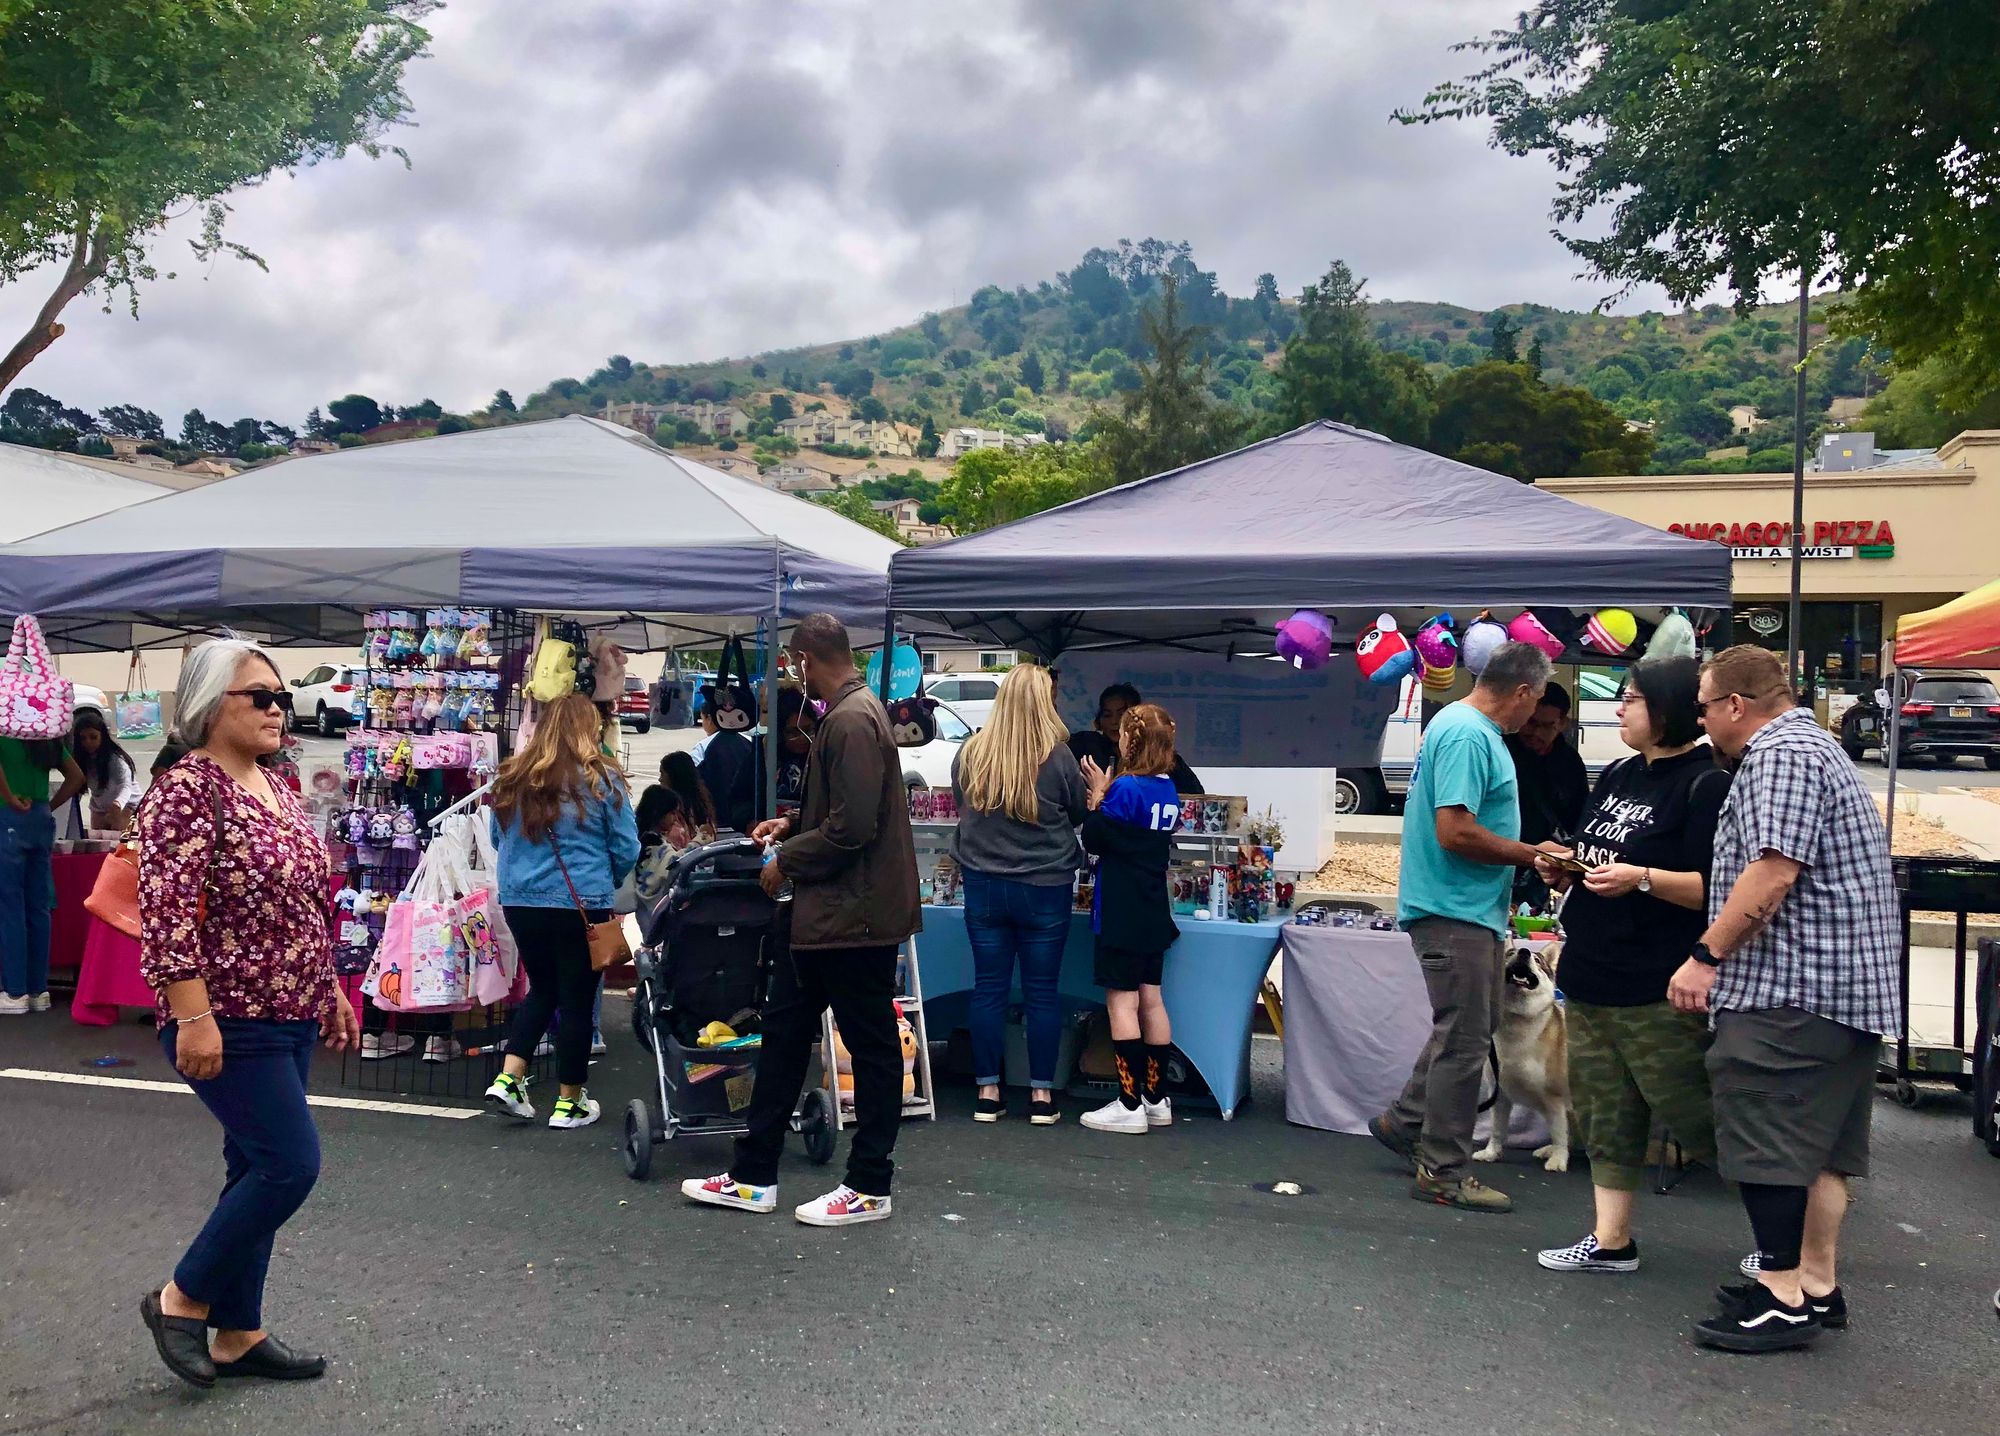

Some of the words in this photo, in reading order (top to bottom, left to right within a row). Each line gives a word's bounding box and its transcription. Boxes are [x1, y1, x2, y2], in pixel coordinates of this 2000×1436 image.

[1814, 521, 1894, 546] PIZZA
[1733, 548, 1763, 557] ITH
[1769, 548, 1782, 557] A
[1754, 615, 1778, 626] 805
[870, 663, 916, 687] Wlcome
[1600, 794, 1652, 821] NEVER
[1584, 819, 1633, 843] LOOK
[1577, 842, 1619, 866] BACK
